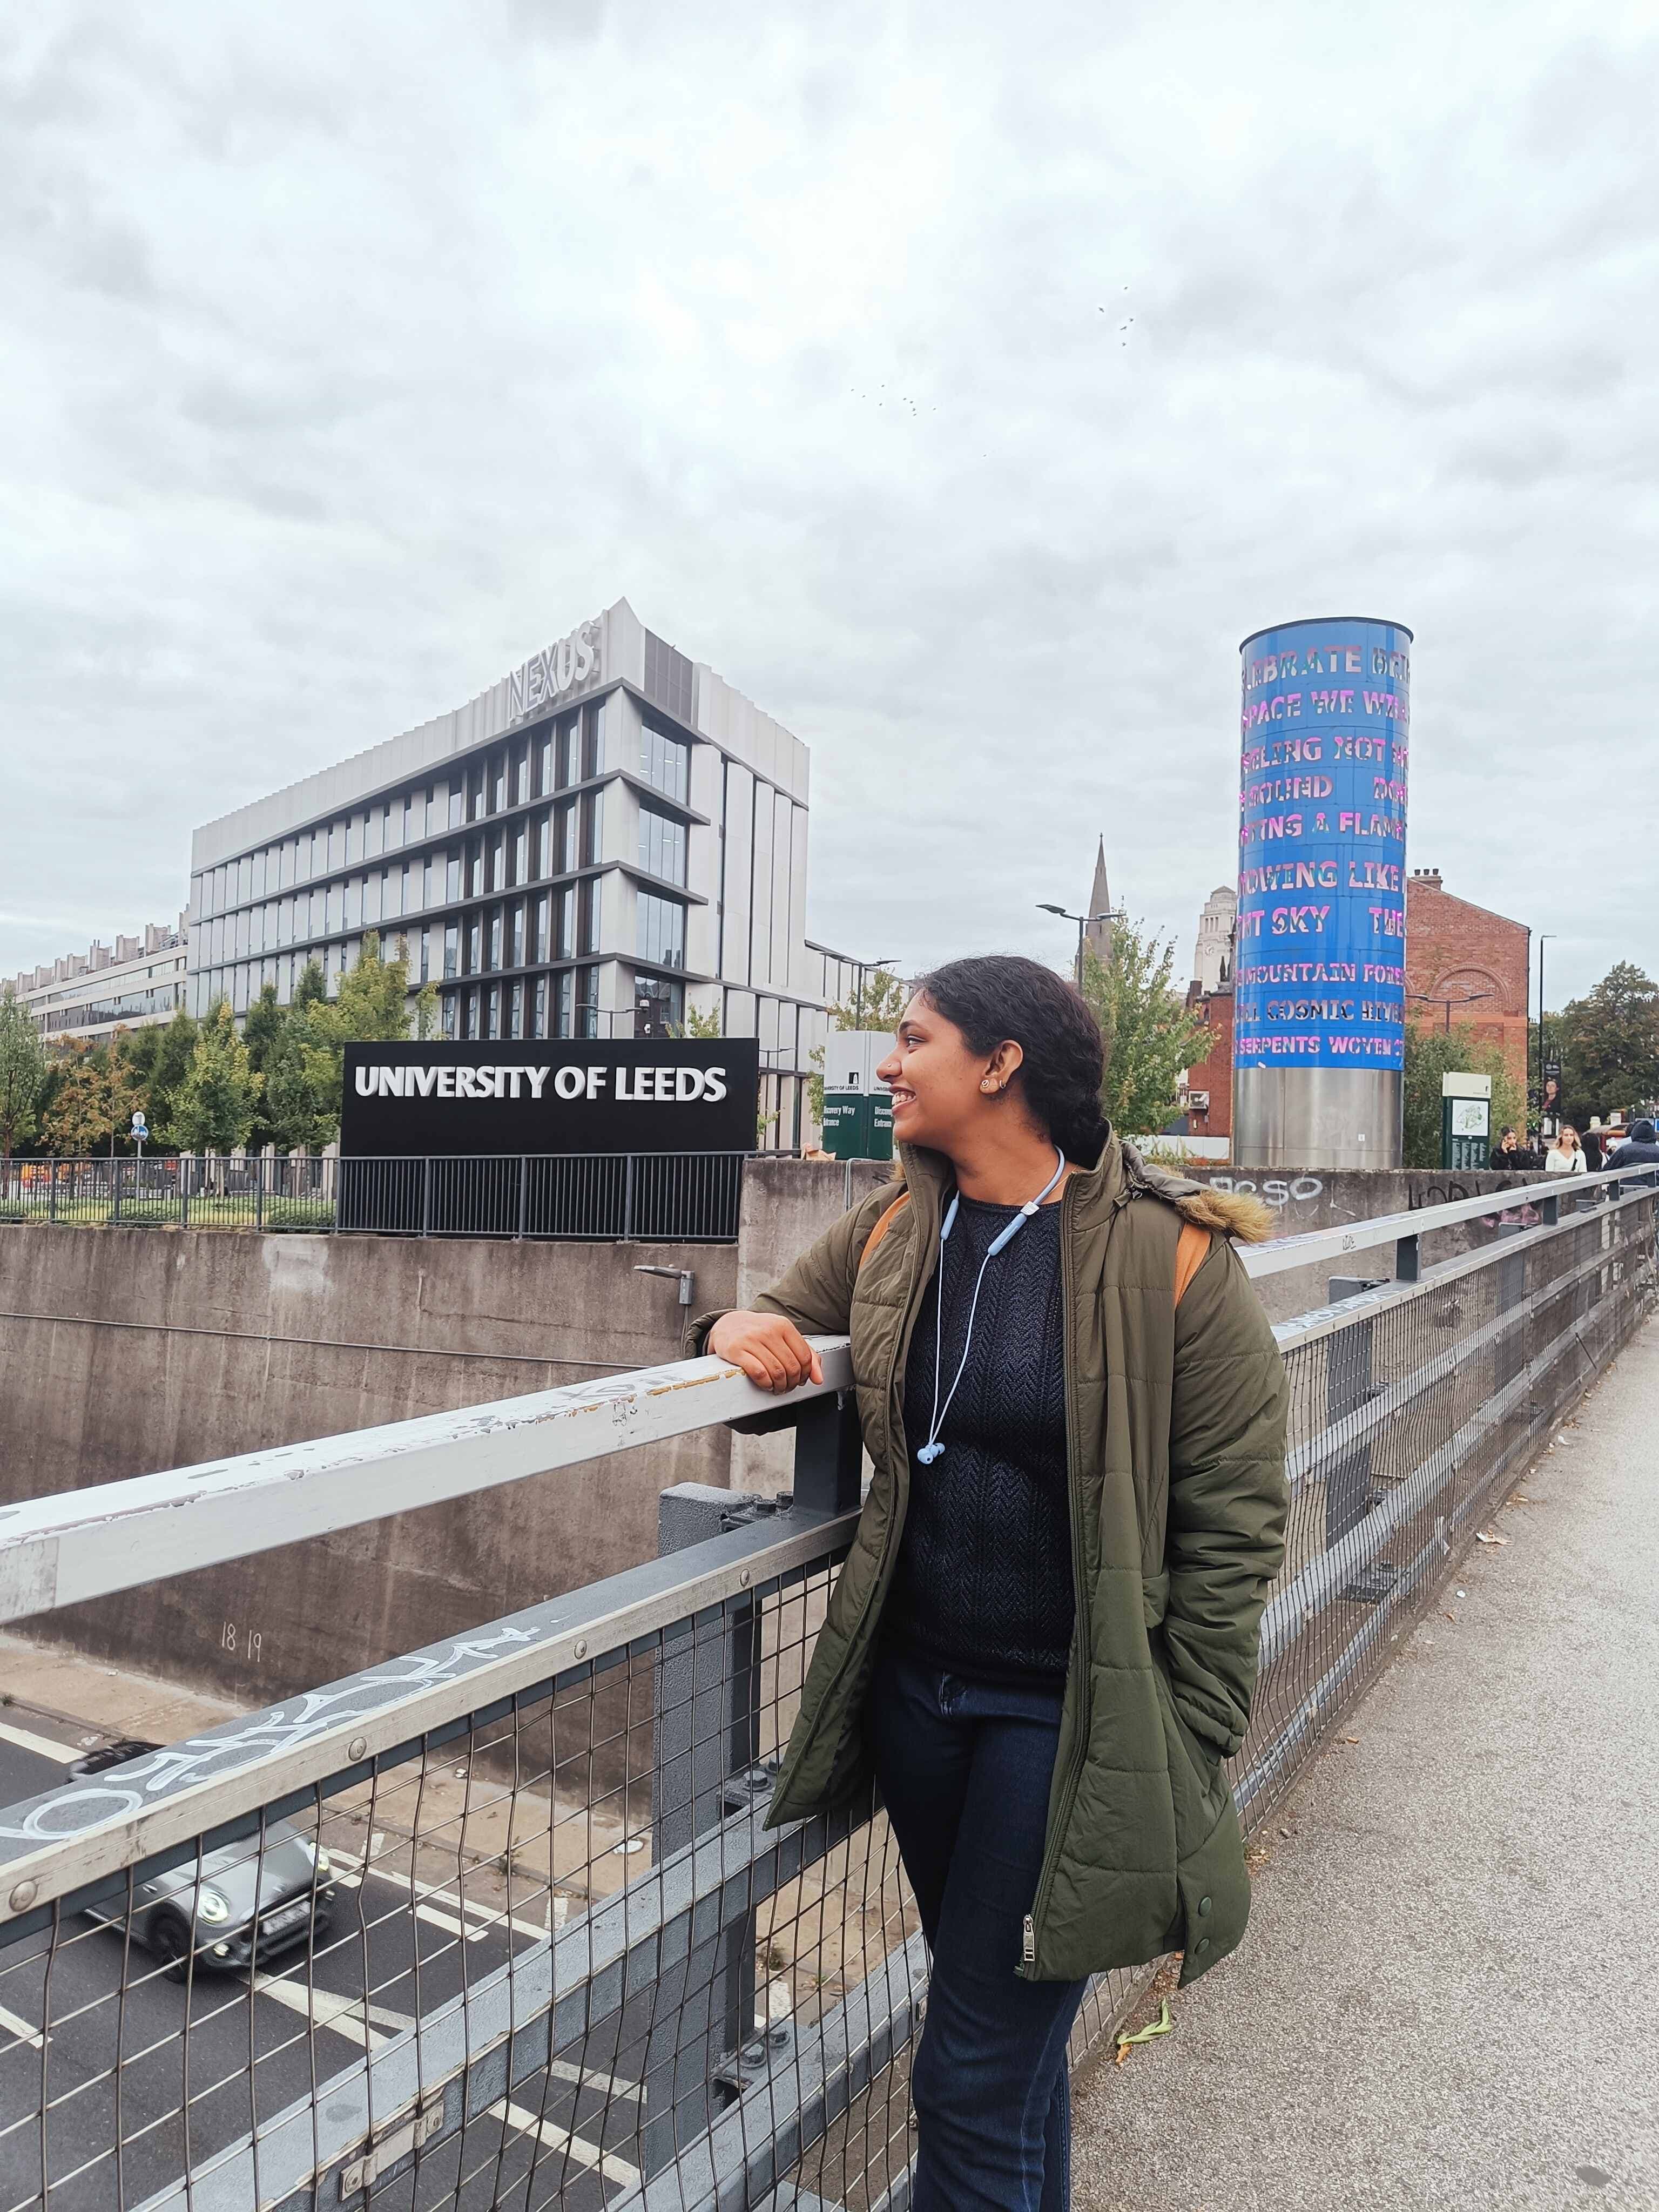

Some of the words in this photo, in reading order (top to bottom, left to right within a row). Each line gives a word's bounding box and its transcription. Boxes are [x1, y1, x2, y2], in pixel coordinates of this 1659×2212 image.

[509, 621, 595, 721] NEXUS
[1311, 690, 1354, 714] WE
[1333, 736, 1386, 762] NOT
[1348, 861, 1399, 892] LIKE
[1271, 906, 1330, 935] SKY
[1246, 963, 1356, 985] MOUNTAIN
[1267, 999, 1354, 1021] COSMIC
[1239, 1036, 1321, 1055] SERPENTS
[1328, 1036, 1392, 1055] WOVEN
[355, 1066, 550, 1098] UNIVERSITY
[554, 1067, 606, 1100] OF
[615, 1067, 727, 1102] LEEDS
[842, 1105, 855, 1116] Way
[221, 1621, 236, 1651] 18
[247, 1629, 262, 1662] 19
